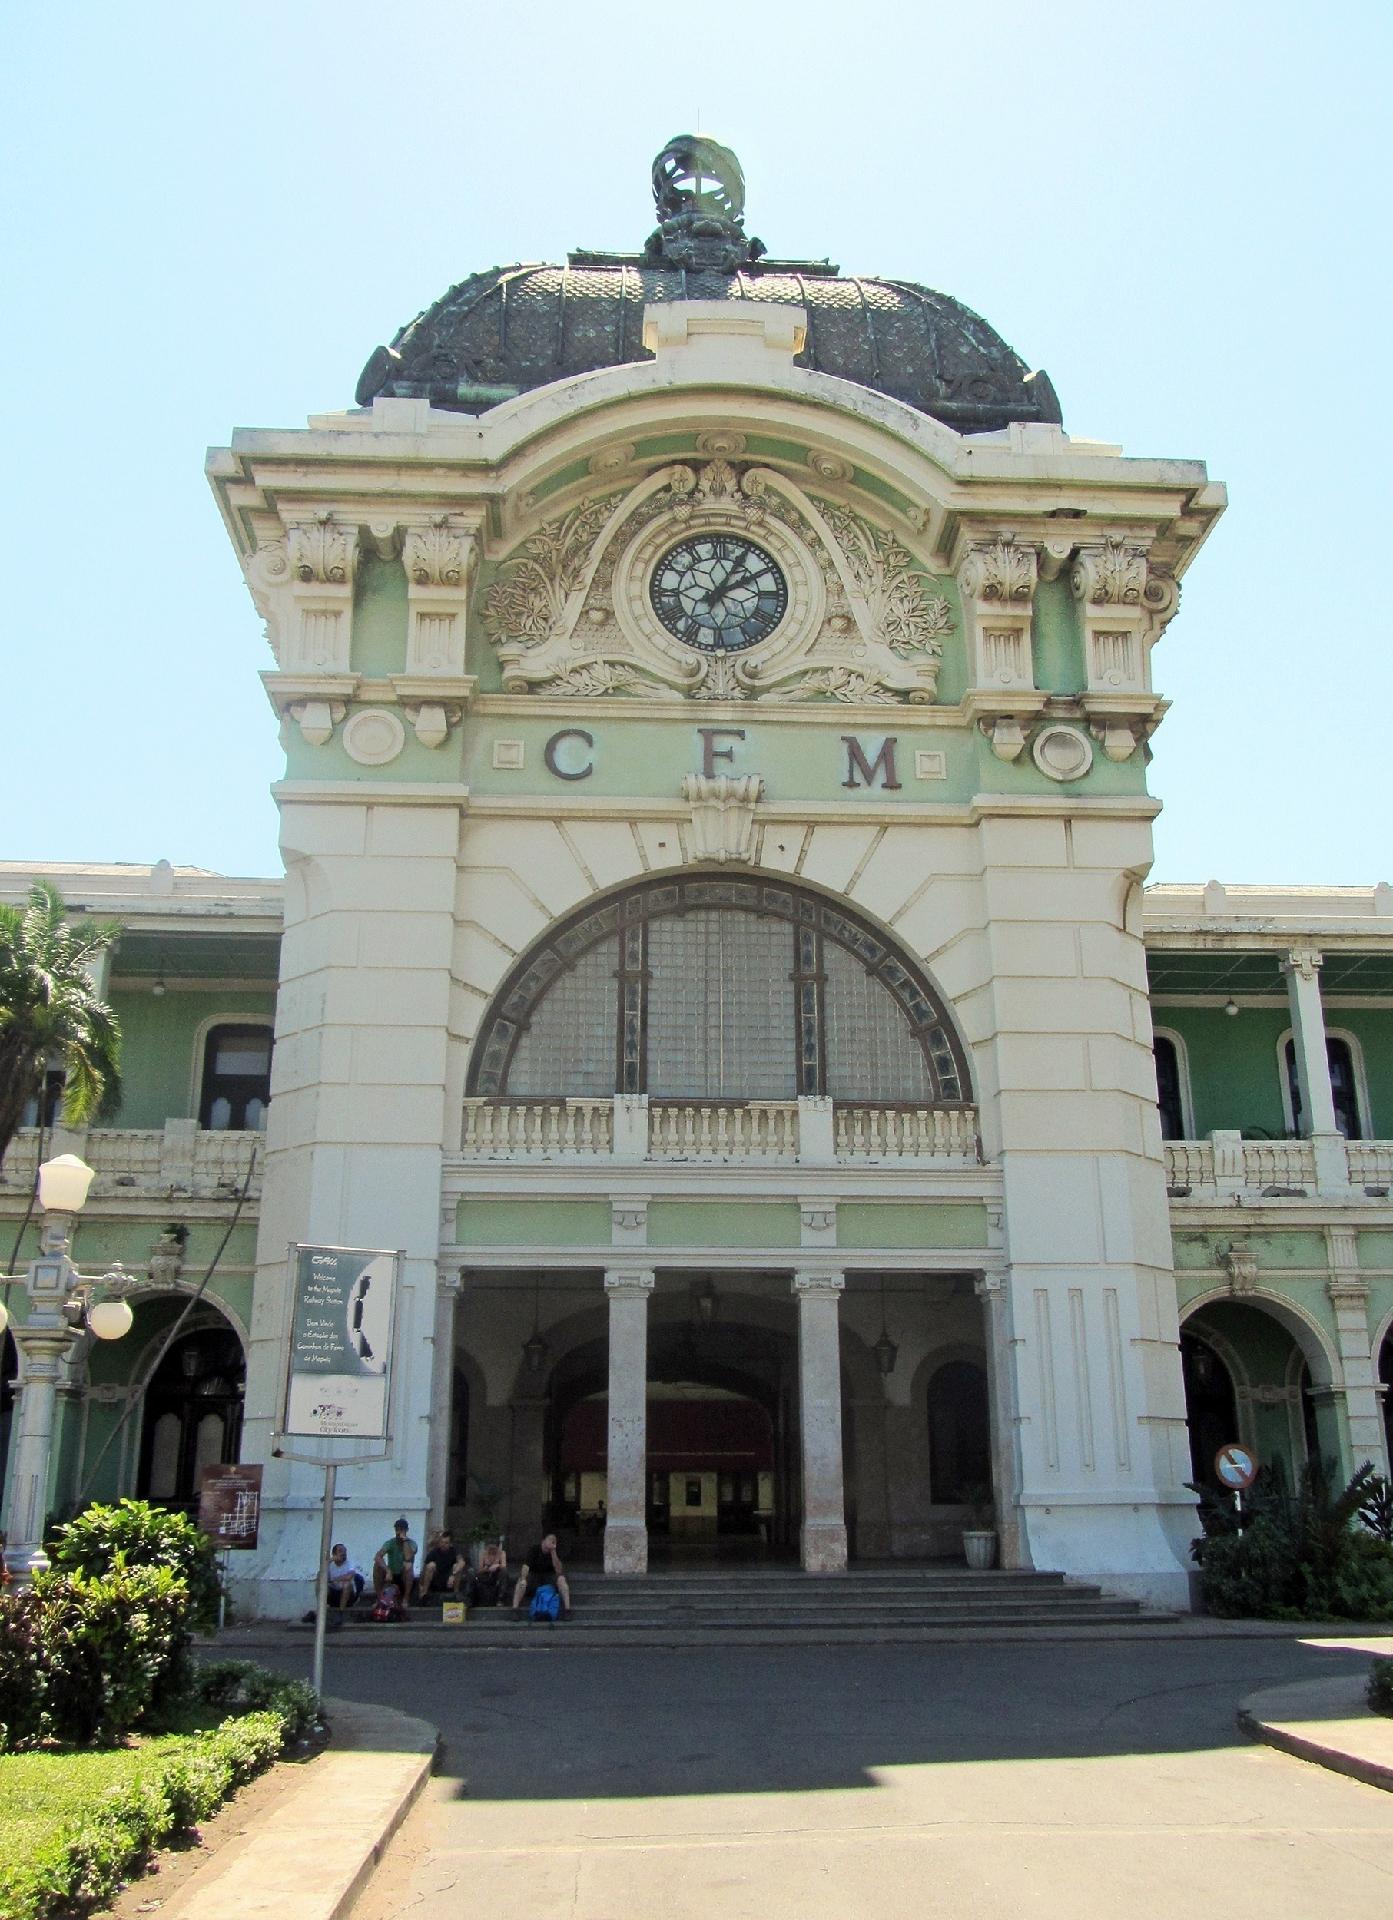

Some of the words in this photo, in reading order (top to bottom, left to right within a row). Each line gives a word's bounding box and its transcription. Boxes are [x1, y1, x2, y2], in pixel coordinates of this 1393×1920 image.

[544, 728, 595, 781] C
[697, 728, 746, 779] F
[840, 735, 902, 790] M
